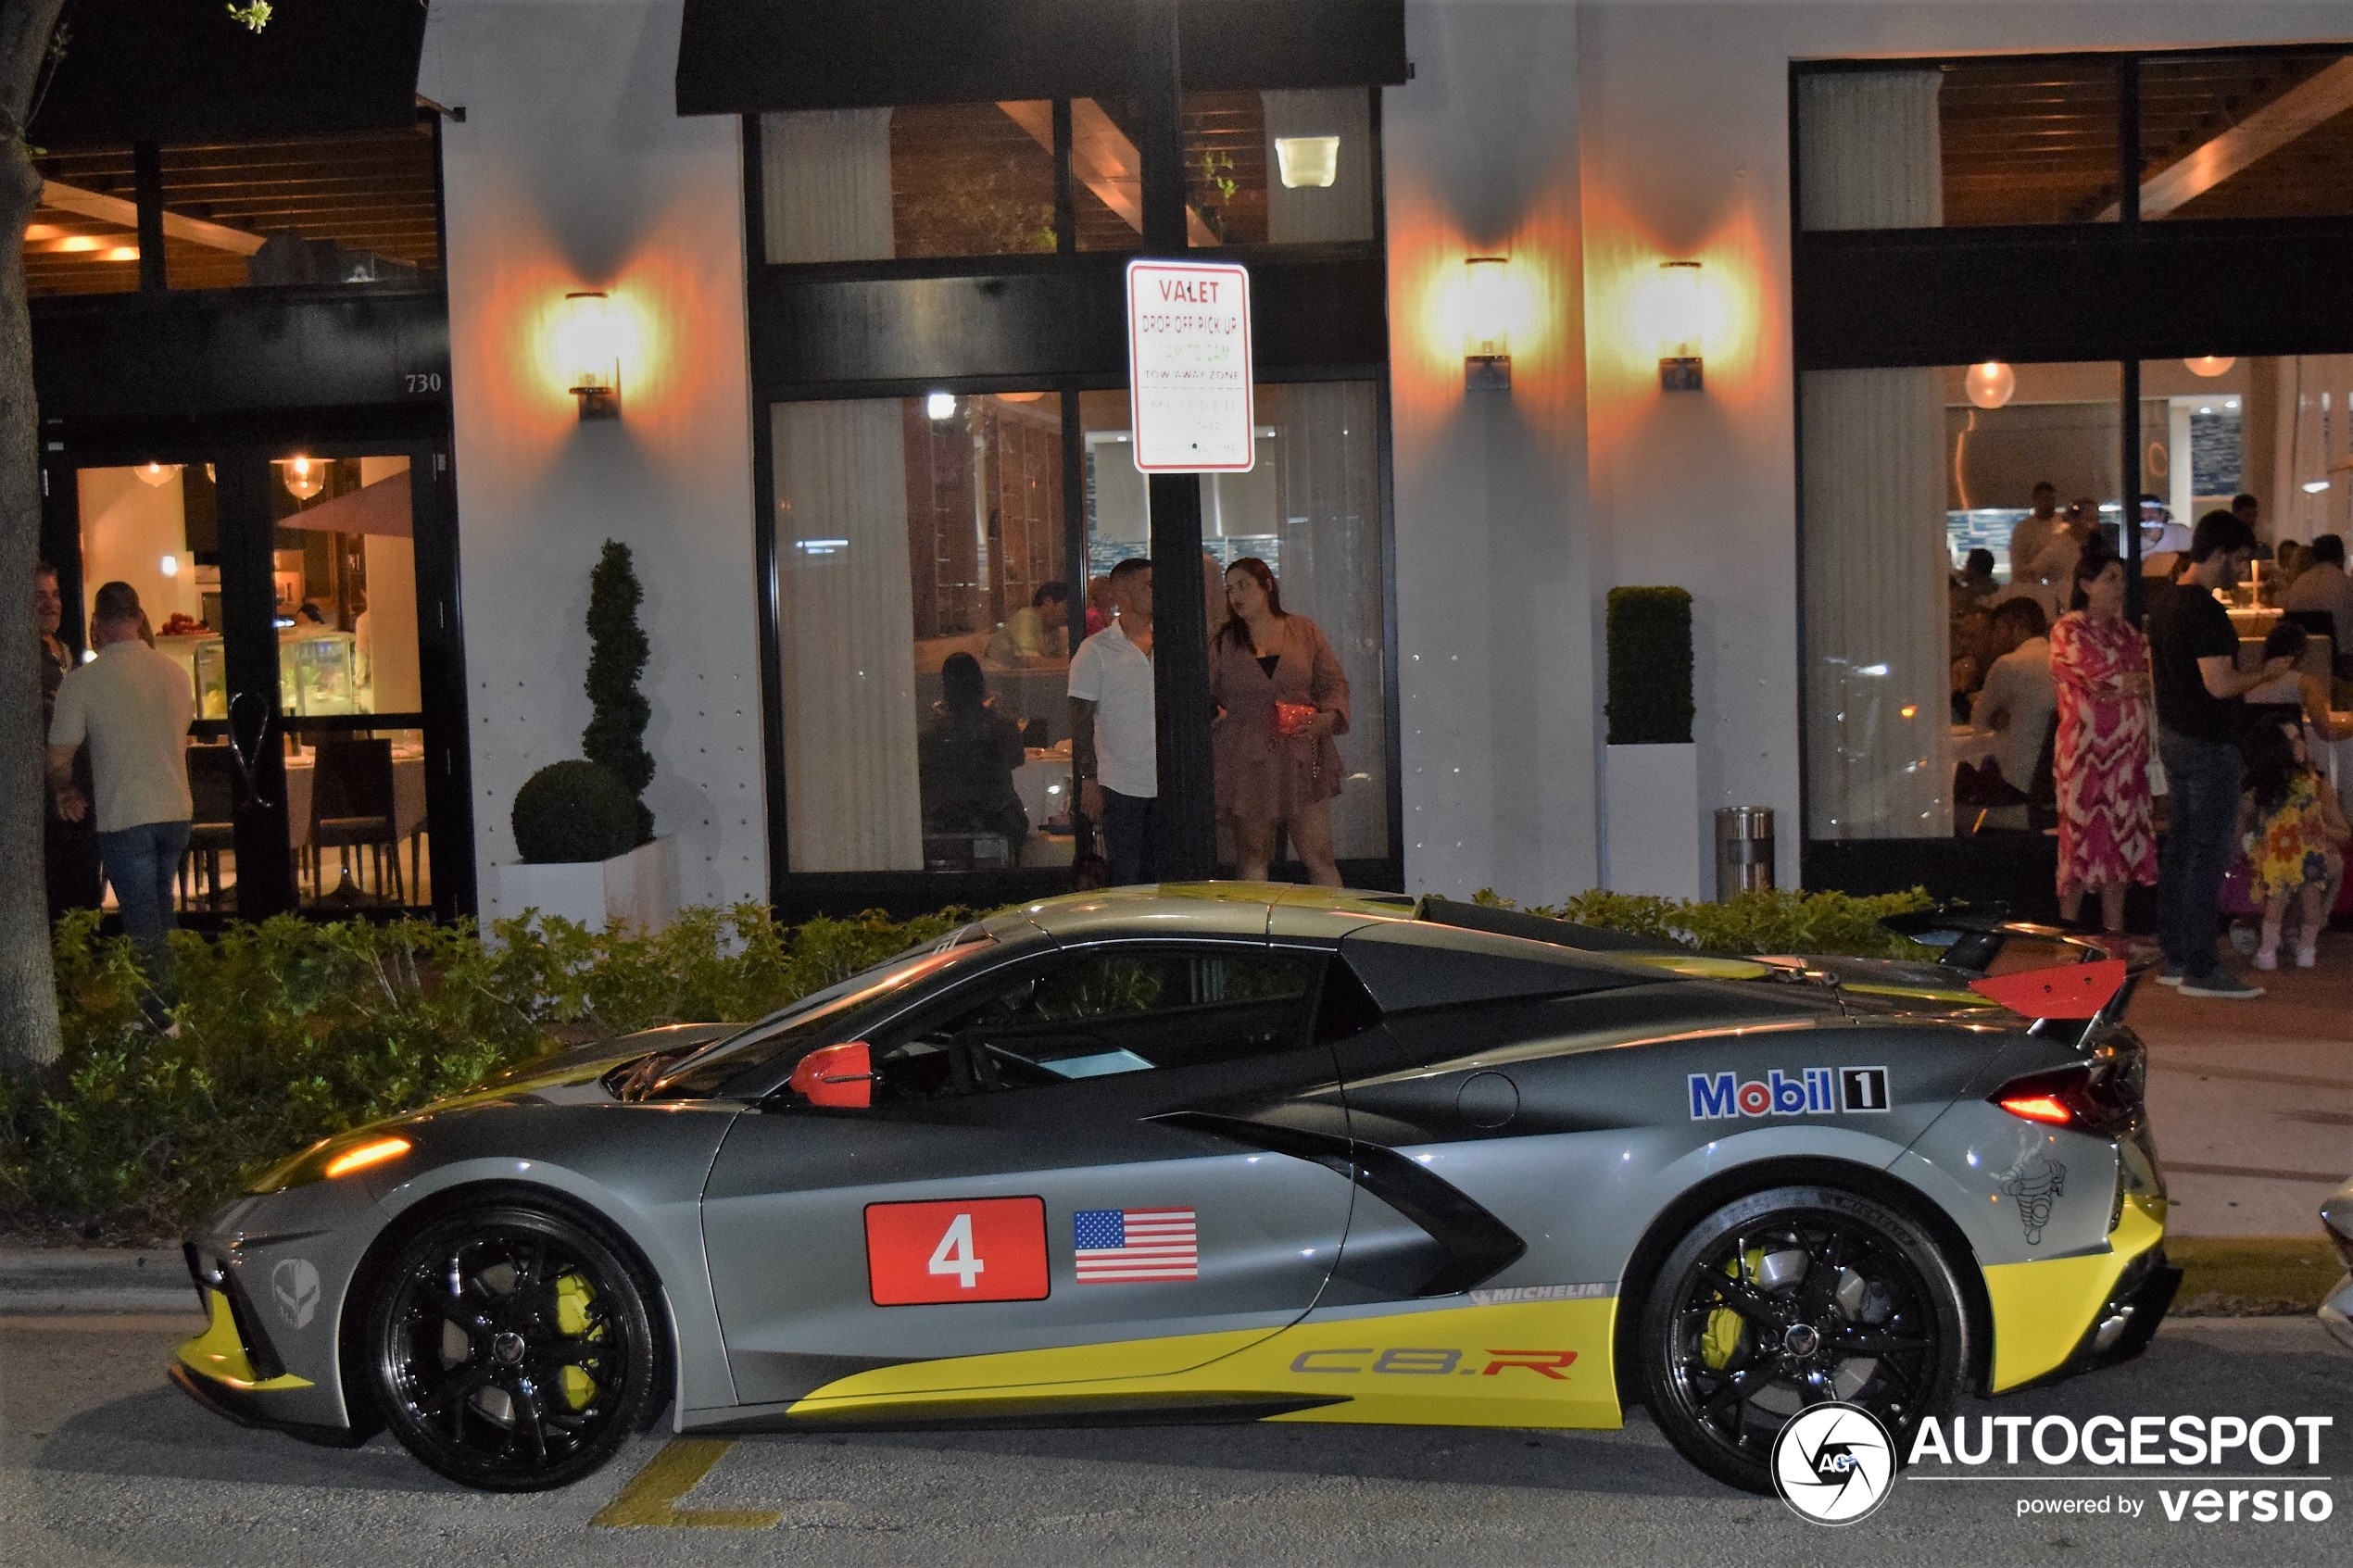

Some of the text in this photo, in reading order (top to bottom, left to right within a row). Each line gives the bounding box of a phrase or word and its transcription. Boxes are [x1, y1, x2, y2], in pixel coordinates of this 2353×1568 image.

[1158, 280, 1219, 304] VALET
[1142, 315, 1238, 334] DROP OFF PICK UP
[406, 372, 442, 393] 730
[1145, 370, 1238, 381] TOW AWAY ZONE
[1688, 1067, 1835, 1121] Mobil
[928, 1213, 985, 1288] 4
[1491, 1282, 1607, 1302] MICHELIN
[1290, 1348, 1579, 1380] C8.R
